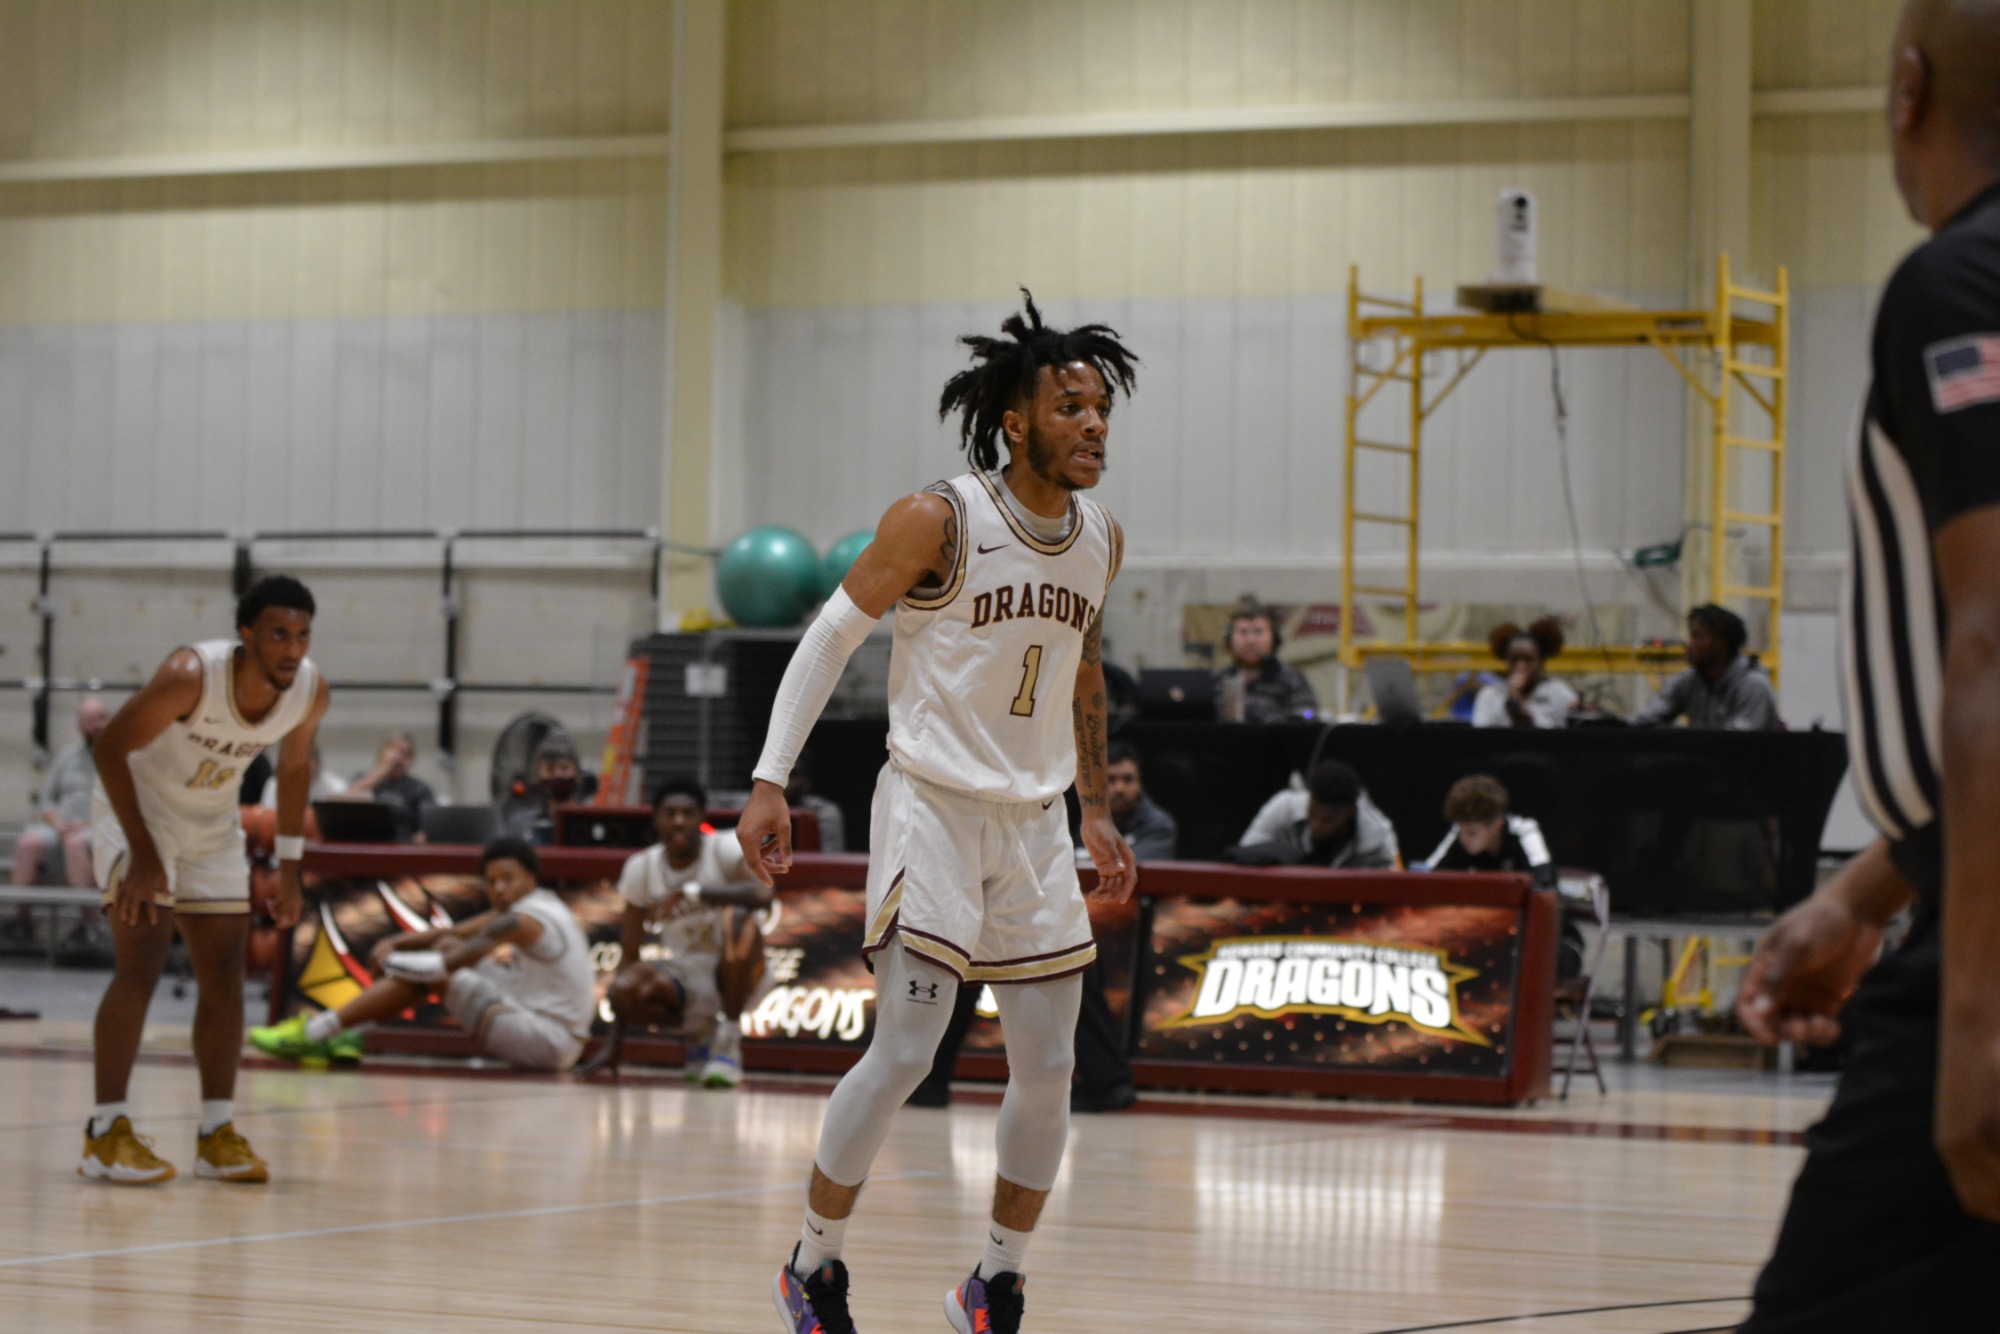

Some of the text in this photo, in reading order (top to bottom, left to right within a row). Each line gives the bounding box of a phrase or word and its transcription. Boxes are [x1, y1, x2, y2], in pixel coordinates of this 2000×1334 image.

[971, 582, 1096, 634] DRAGONS
[1009, 644, 1043, 718] 1
[1193, 957, 1452, 1029] DRAGONS
